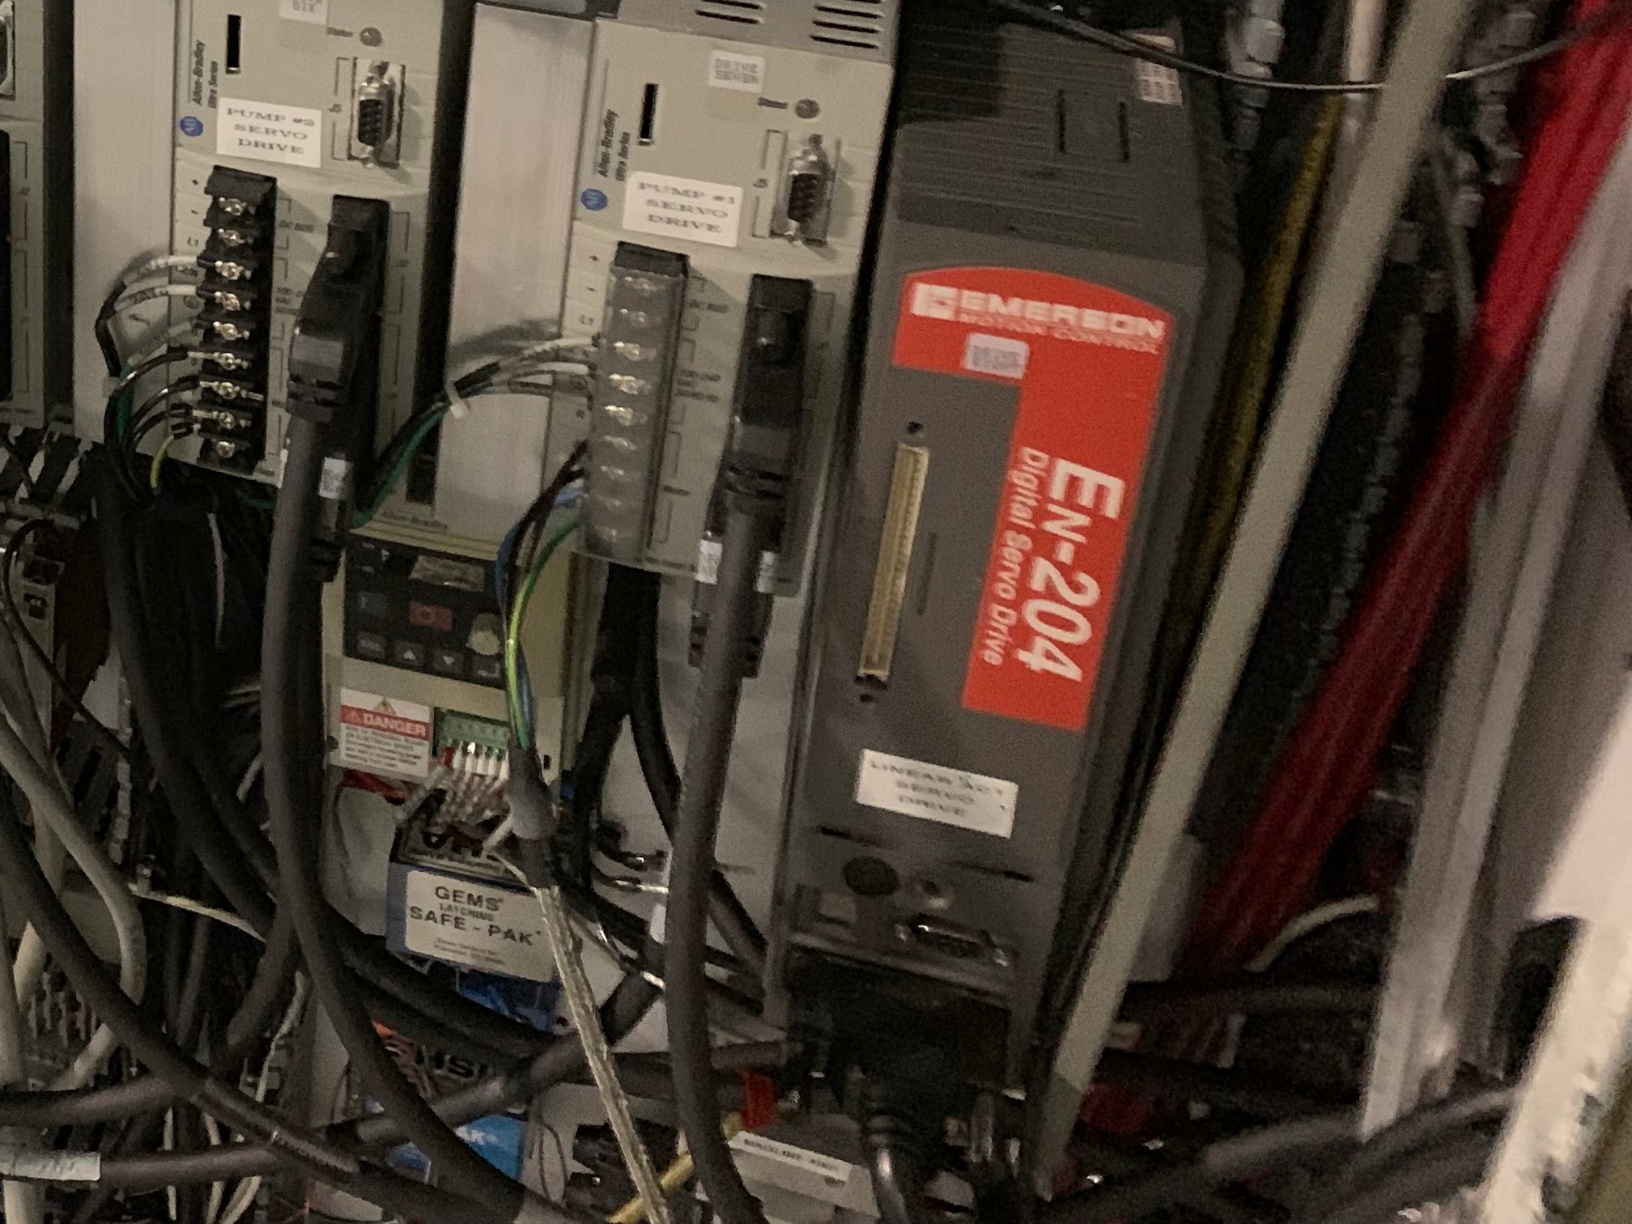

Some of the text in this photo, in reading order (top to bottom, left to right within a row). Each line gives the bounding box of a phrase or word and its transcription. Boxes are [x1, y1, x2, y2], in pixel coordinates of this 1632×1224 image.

[192, 39, 207, 107] Allen-Bradley
[226, 107, 315, 127] PUMP #2
[234, 123, 308, 141] SERVO
[237, 138, 304, 155] DRIVE
[637, 181, 735, 204] PUMP #1
[644, 198, 728, 218] SERVO
[647, 213, 722, 233] DRIVE
[960, 288, 1166, 339] EMERSON
[982, 446, 1050, 666] Digital Servo Drive
[362, 712, 427, 736] DANGER
[434, 885, 500, 912] GEMS
[409, 905, 467, 932] SAFE
